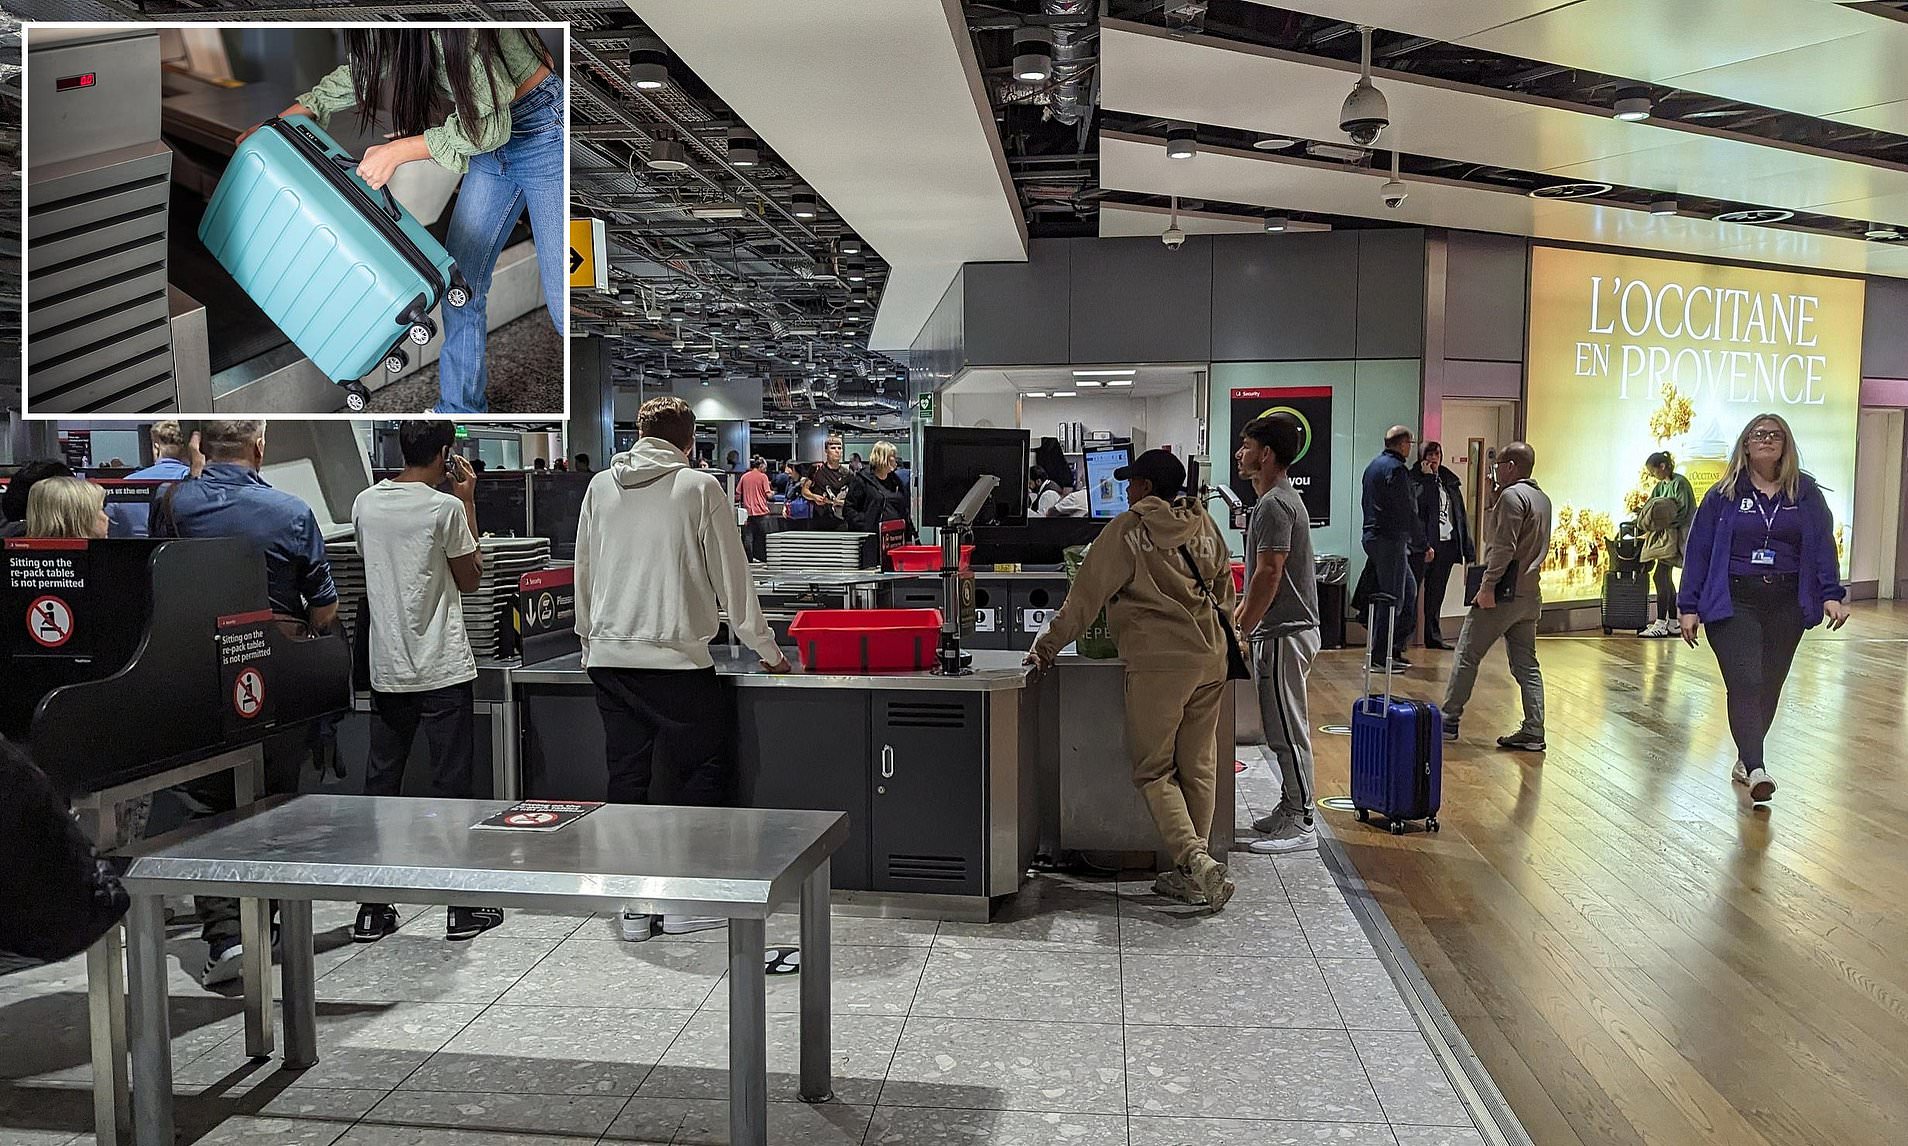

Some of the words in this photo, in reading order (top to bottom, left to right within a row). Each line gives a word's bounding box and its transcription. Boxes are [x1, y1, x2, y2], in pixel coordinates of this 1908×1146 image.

[1588, 276, 1820, 347] L'OCCITANE
[1574, 342, 1611, 377] EN
[1618, 344, 1827, 406] PROVENCE
[1288, 476, 1311, 487] you
[9, 557, 40, 569] Sitting
[42, 559, 55, 567] on
[56, 557, 73, 568] the
[10, 568, 45, 579] re-pack
[46, 568, 75, 578] tables
[11, 578, 20, 588] is
[20, 579, 37, 588] not
[38, 578, 85, 590] permitted
[222, 633, 243, 645] Sitting
[243, 632, 253, 641] on
[252, 629, 264, 639] the
[222, 643, 246, 655] re-pack
[246, 640, 265, 650] tables
[222, 656, 229, 665] is
[229, 654, 241, 664] not
[241, 647, 271, 663] permitted
